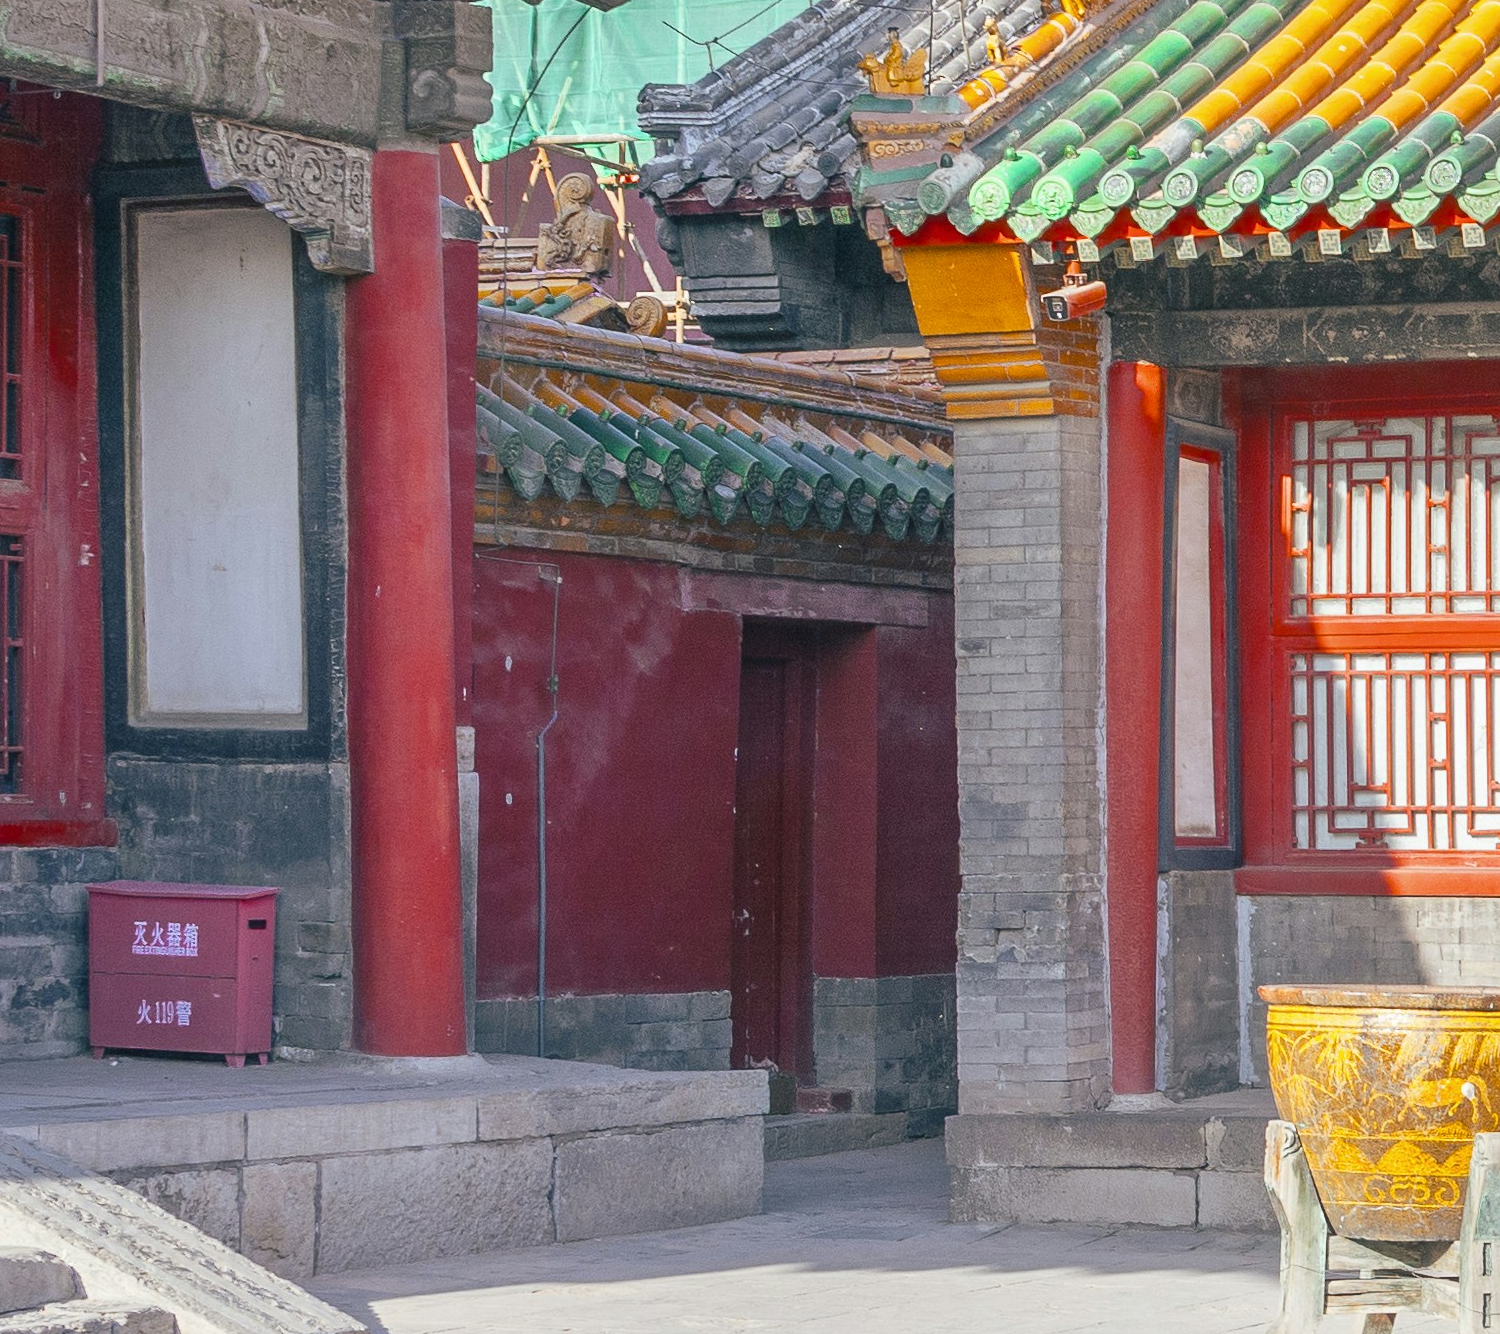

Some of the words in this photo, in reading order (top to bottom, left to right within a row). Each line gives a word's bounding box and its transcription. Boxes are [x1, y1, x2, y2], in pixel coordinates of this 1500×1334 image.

[133, 921, 199, 948] 灭火器箱
[136, 999, 192, 1026] 火119警
